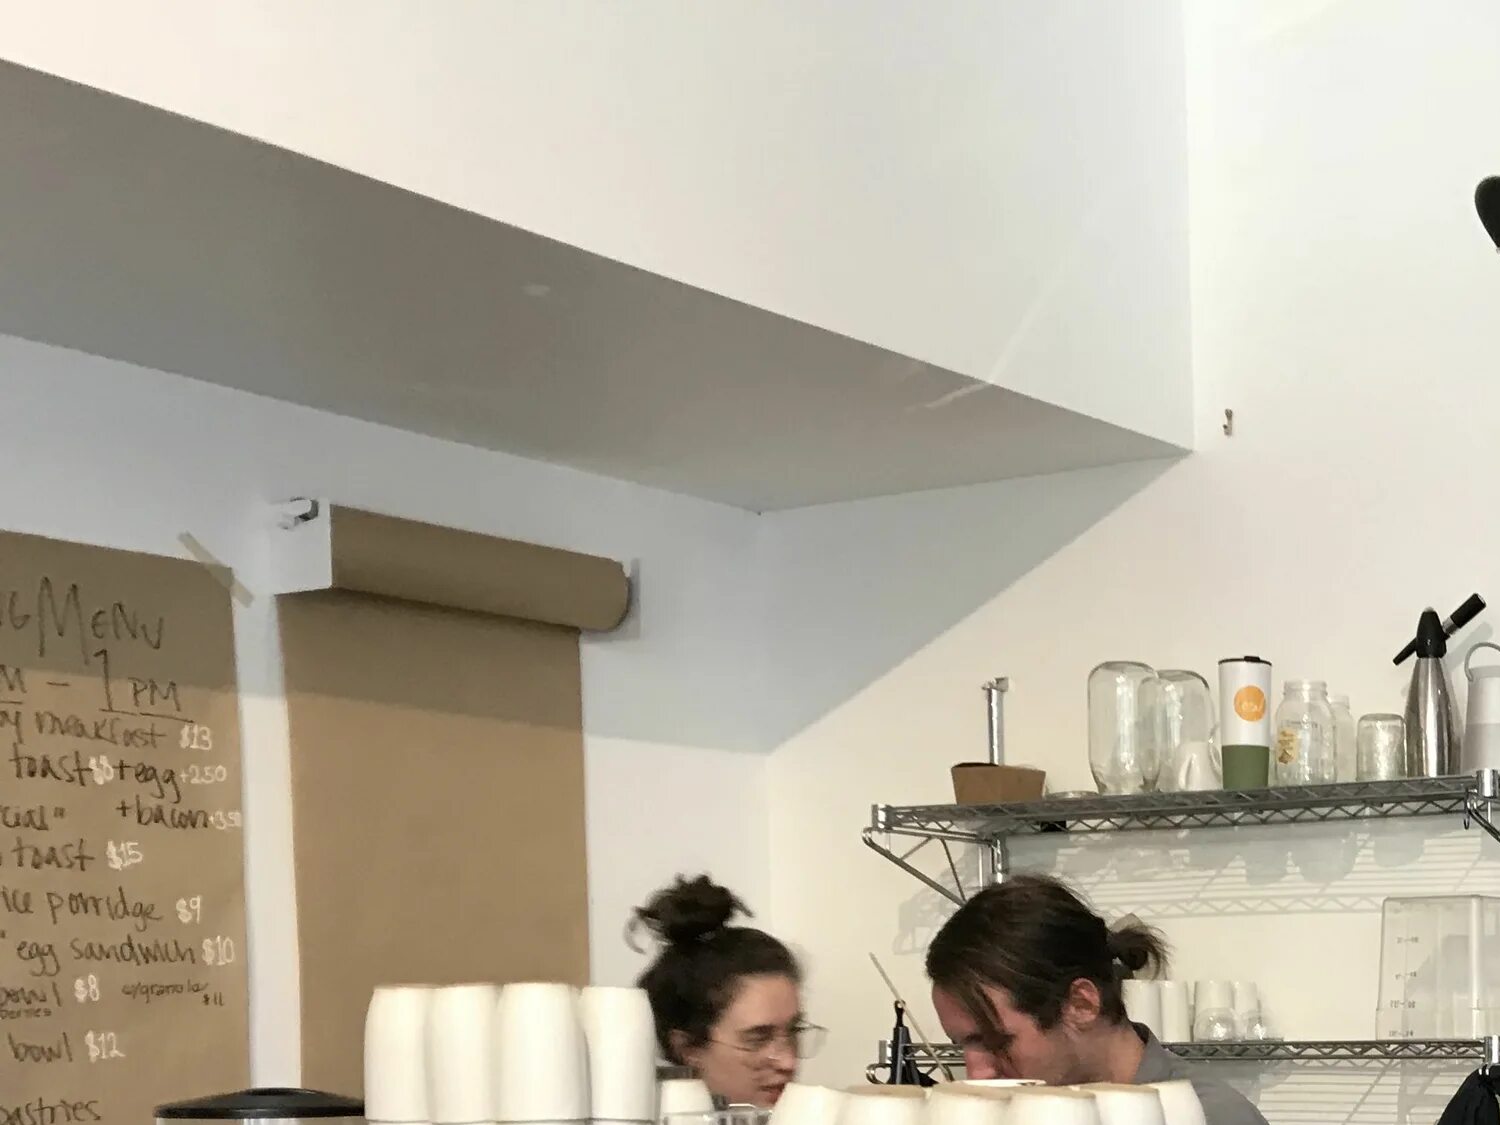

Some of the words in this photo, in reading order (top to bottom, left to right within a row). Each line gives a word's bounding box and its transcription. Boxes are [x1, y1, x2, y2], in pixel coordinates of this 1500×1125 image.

[127, 676, 181, 712] PM
[179, 724, 213, 751] $13
[9, 742, 93, 787] toast
[179, 765, 228, 785] +250
[11, 836, 96, 872] toast
[46, 886, 164, 933] porridge
[175, 895, 202, 924] $9
[17, 941, 61, 977] egg
[70, 934, 196, 967] sandwich
[201, 935, 236, 966] $10
[73, 974, 100, 1003] $8
[8, 1031, 74, 1063] bowl
[84, 1029, 126, 1064] $12
